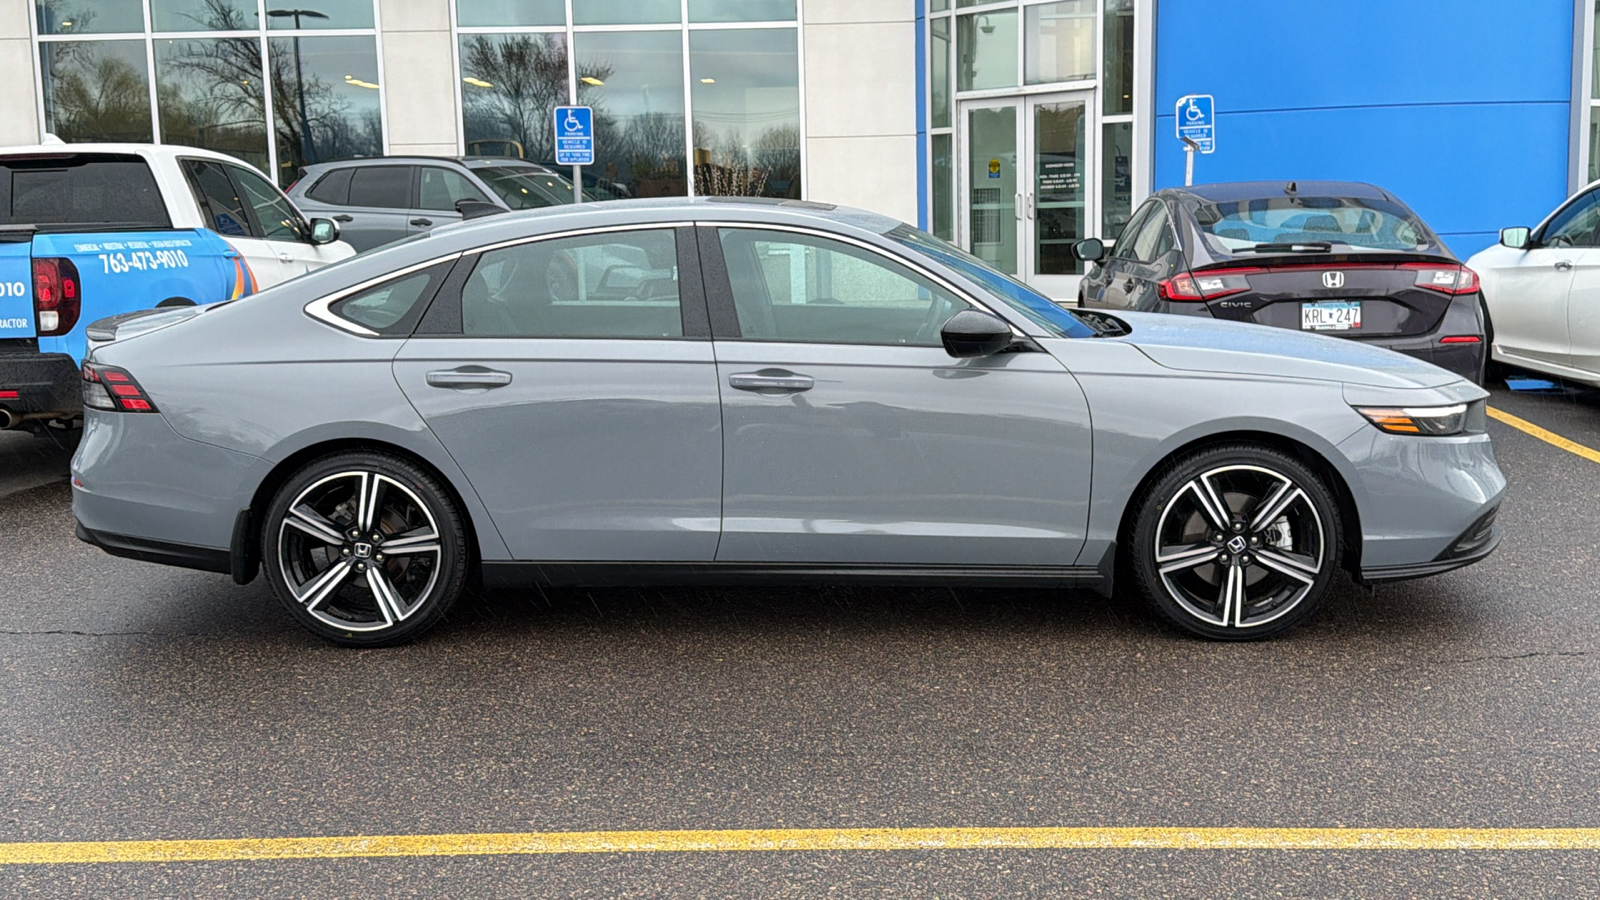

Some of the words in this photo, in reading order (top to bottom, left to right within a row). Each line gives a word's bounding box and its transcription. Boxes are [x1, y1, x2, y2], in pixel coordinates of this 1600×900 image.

[98, 250, 188, 274] 763-473-9010
[1305, 309, 1327, 323] KRL
[1336, 308, 1358, 323] 247
